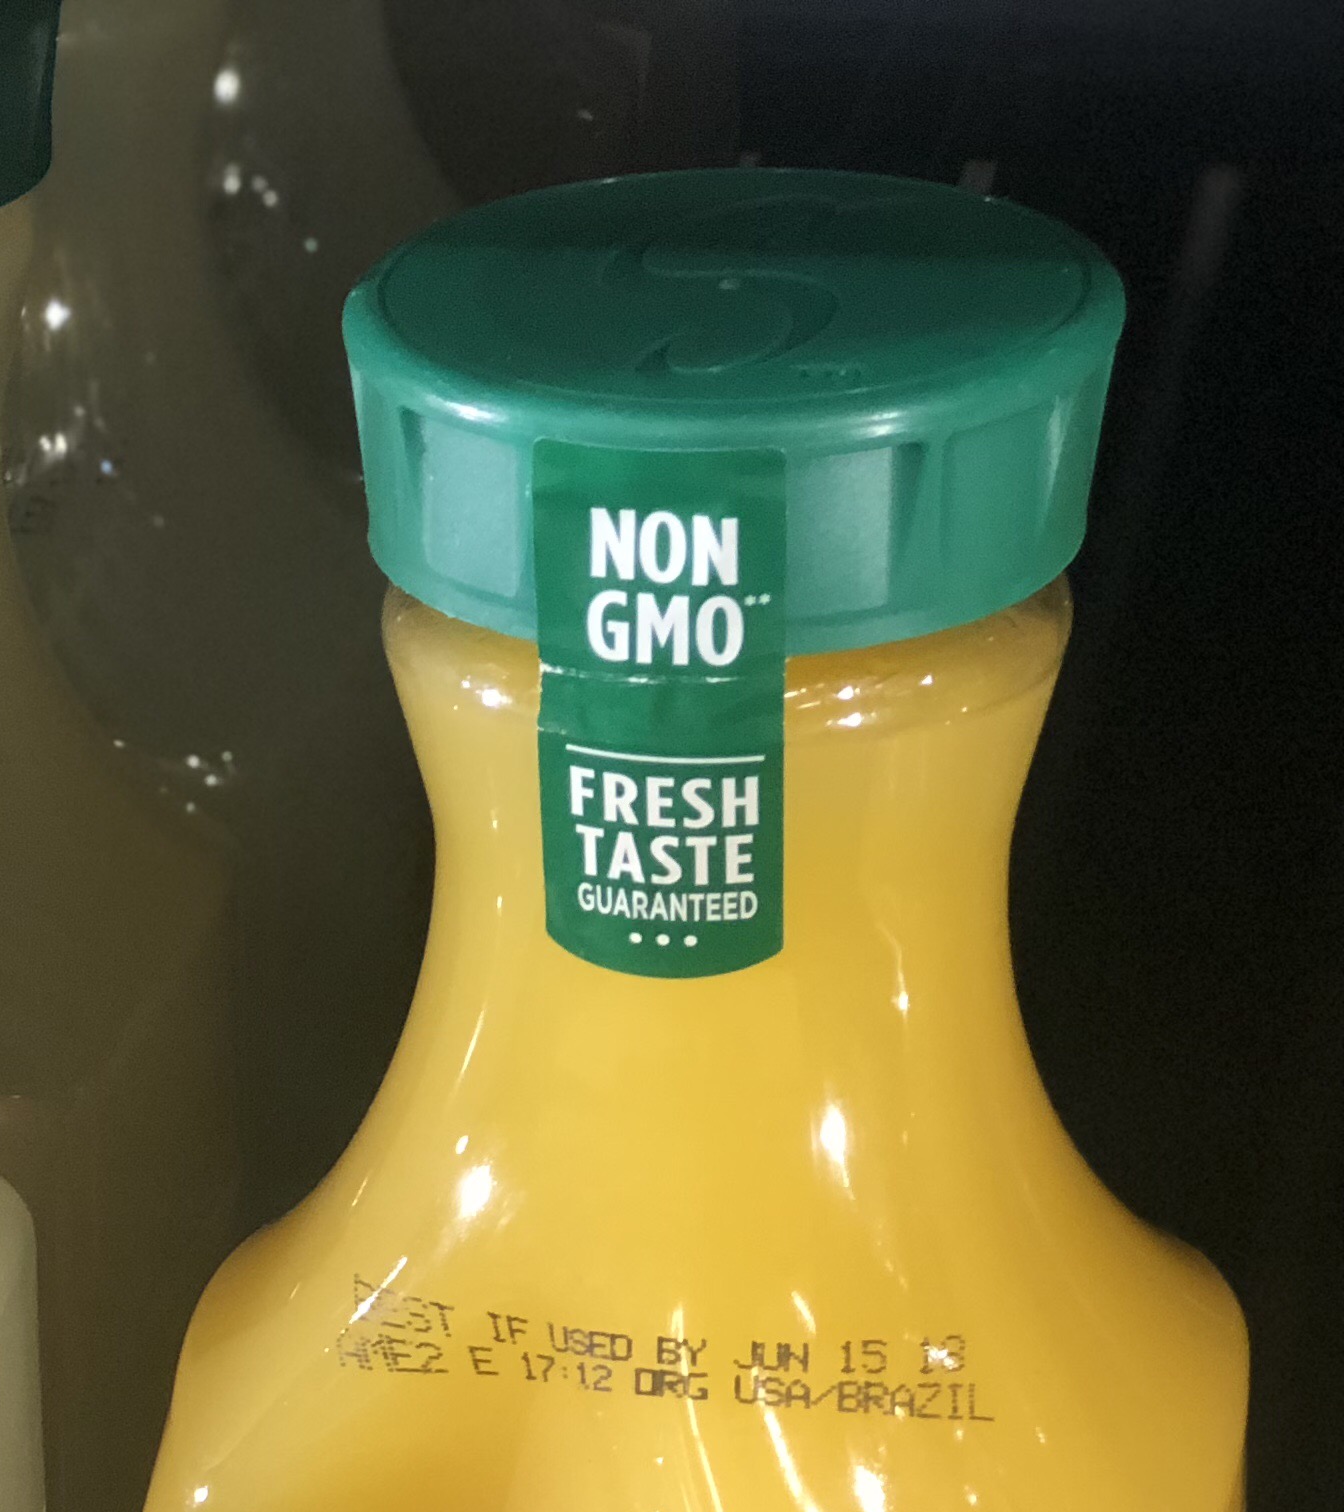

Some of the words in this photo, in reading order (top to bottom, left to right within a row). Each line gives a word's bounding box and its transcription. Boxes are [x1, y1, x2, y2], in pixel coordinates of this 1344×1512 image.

[589, 507, 739, 586] NON
[569, 765, 761, 829] FRESH
[575, 825, 756, 887] TASTE
[577, 882, 758, 922] GUARANTEED
[487, 1310, 528, 1345] IF
[548, 1322, 633, 1362] USED
[657, 1335, 708, 1368] BY
[733, 1340, 809, 1373] JUN
[841, 1339, 888, 1374] 15
[468, 1345, 500, 1376] E
[521, 1351, 613, 1393] 17:12
[734, 1374, 995, 1422] USA/BRAZIL
